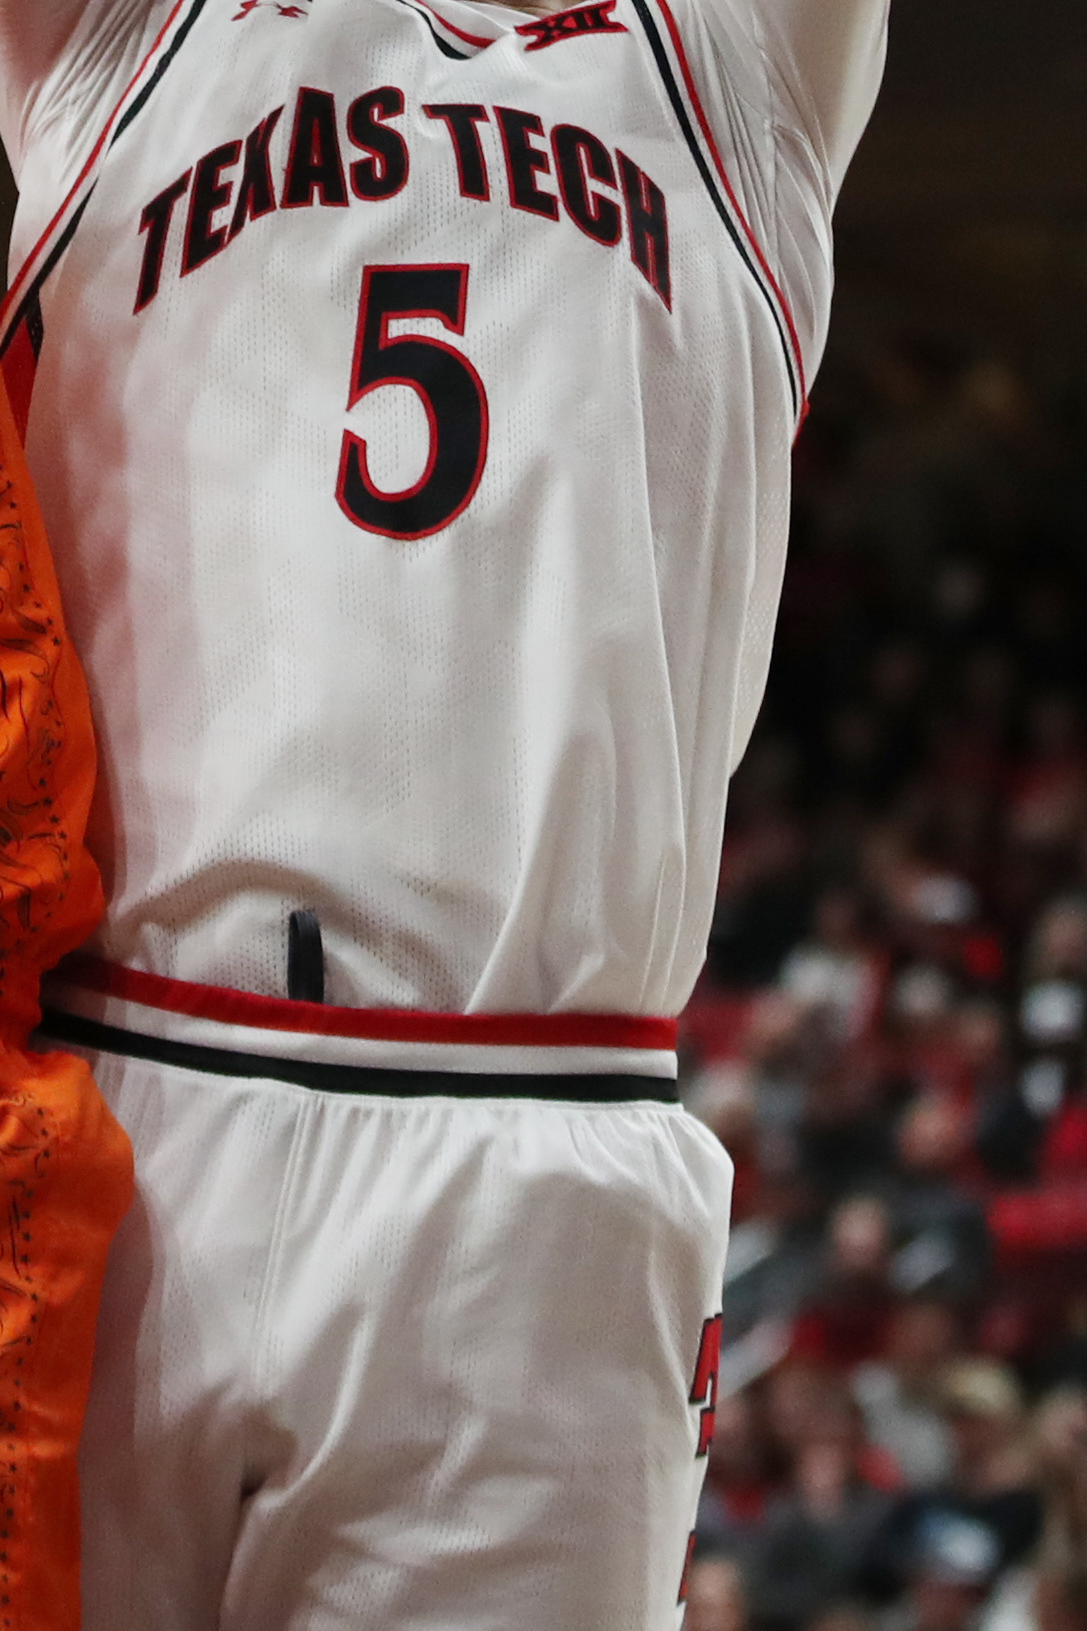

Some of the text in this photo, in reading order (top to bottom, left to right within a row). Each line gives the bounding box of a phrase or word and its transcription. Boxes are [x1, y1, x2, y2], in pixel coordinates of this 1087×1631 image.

[133, 85, 672, 315] TEXAS TECH
[335, 263, 489, 541] 5
